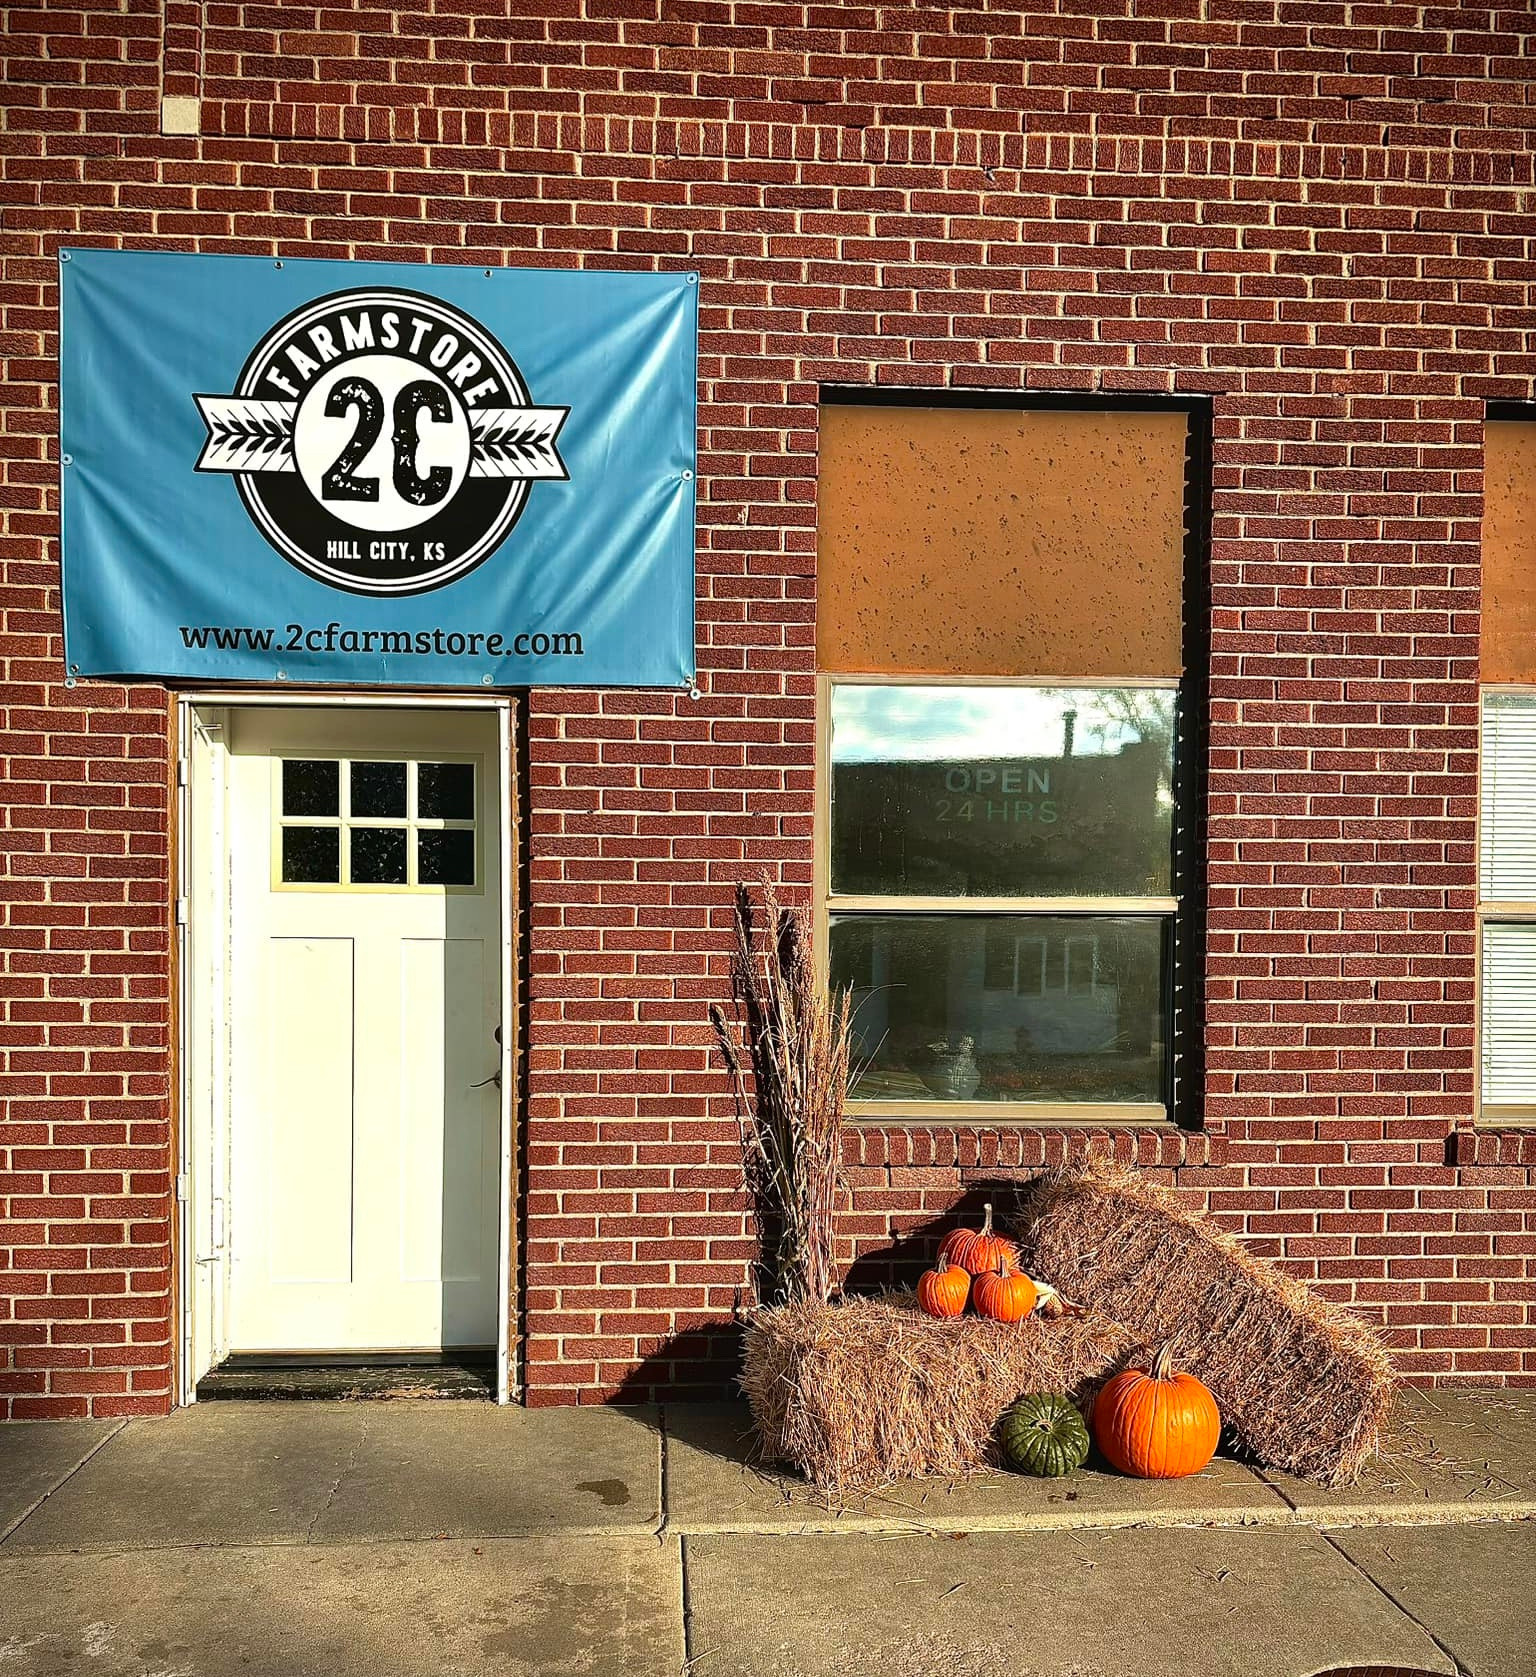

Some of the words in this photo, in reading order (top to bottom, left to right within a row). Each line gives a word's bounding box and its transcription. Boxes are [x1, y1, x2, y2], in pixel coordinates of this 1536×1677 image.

[266, 312, 498, 407] FARMSTORE
[321, 376, 453, 506] 2C
[326, 540, 361, 560] HILL
[369, 541, 415, 562] CITY,
[423, 542, 446, 561] KS
[179, 623, 584, 656] www.2cfarmstore.com
[945, 767, 1051, 793] OPEN
[935, 800, 975, 822] 24
[987, 801, 1059, 824] HRS
